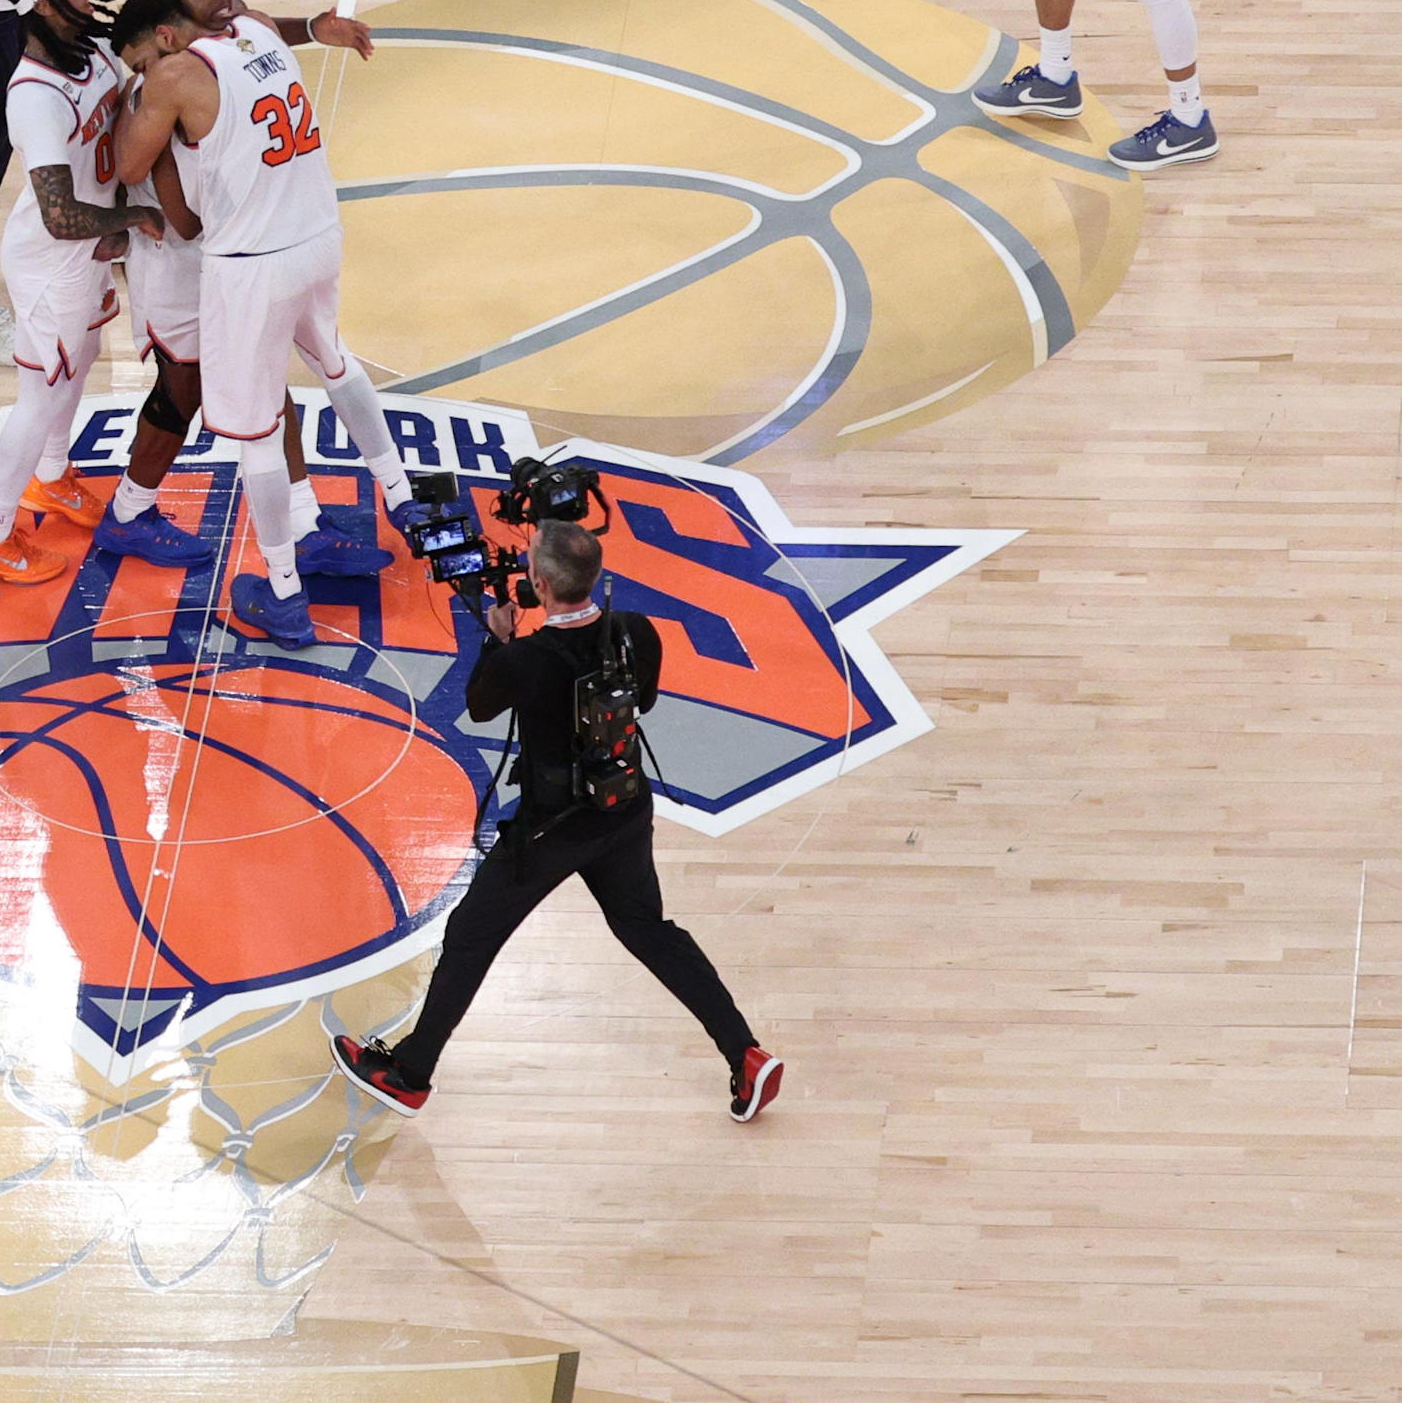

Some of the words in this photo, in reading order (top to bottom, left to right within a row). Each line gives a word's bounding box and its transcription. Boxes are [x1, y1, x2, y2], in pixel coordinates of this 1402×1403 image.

[244, 57, 287, 84] TOWNS
[249, 81, 322, 169] 32
[95, 131, 117, 185] 0
